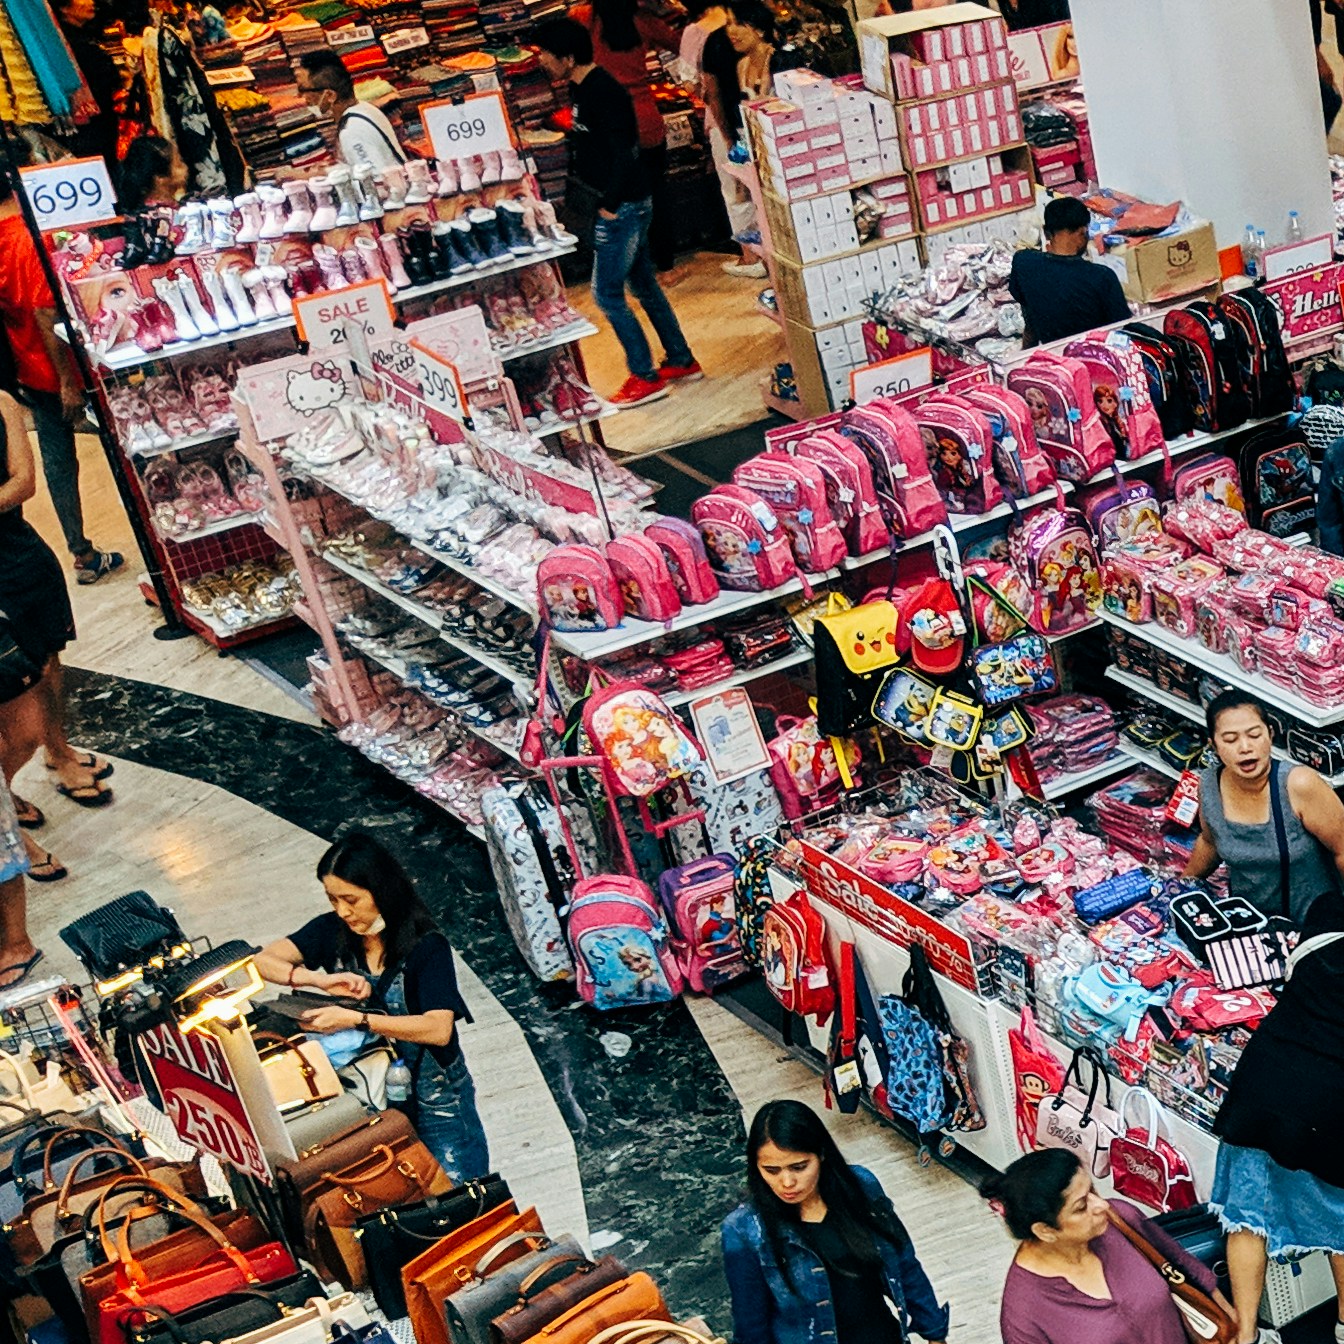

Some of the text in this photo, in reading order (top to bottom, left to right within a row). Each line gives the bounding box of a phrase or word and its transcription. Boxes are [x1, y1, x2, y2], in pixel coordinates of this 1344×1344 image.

[447, 117, 486, 142] 699
[32, 175, 103, 215] 699
[317, 297, 370, 324] SALE
[419, 363, 458, 409] 399
[819, 861, 879, 921] Sale
[140, 1022, 235, 1093] SALE
[163, 1088, 246, 1166] 250
